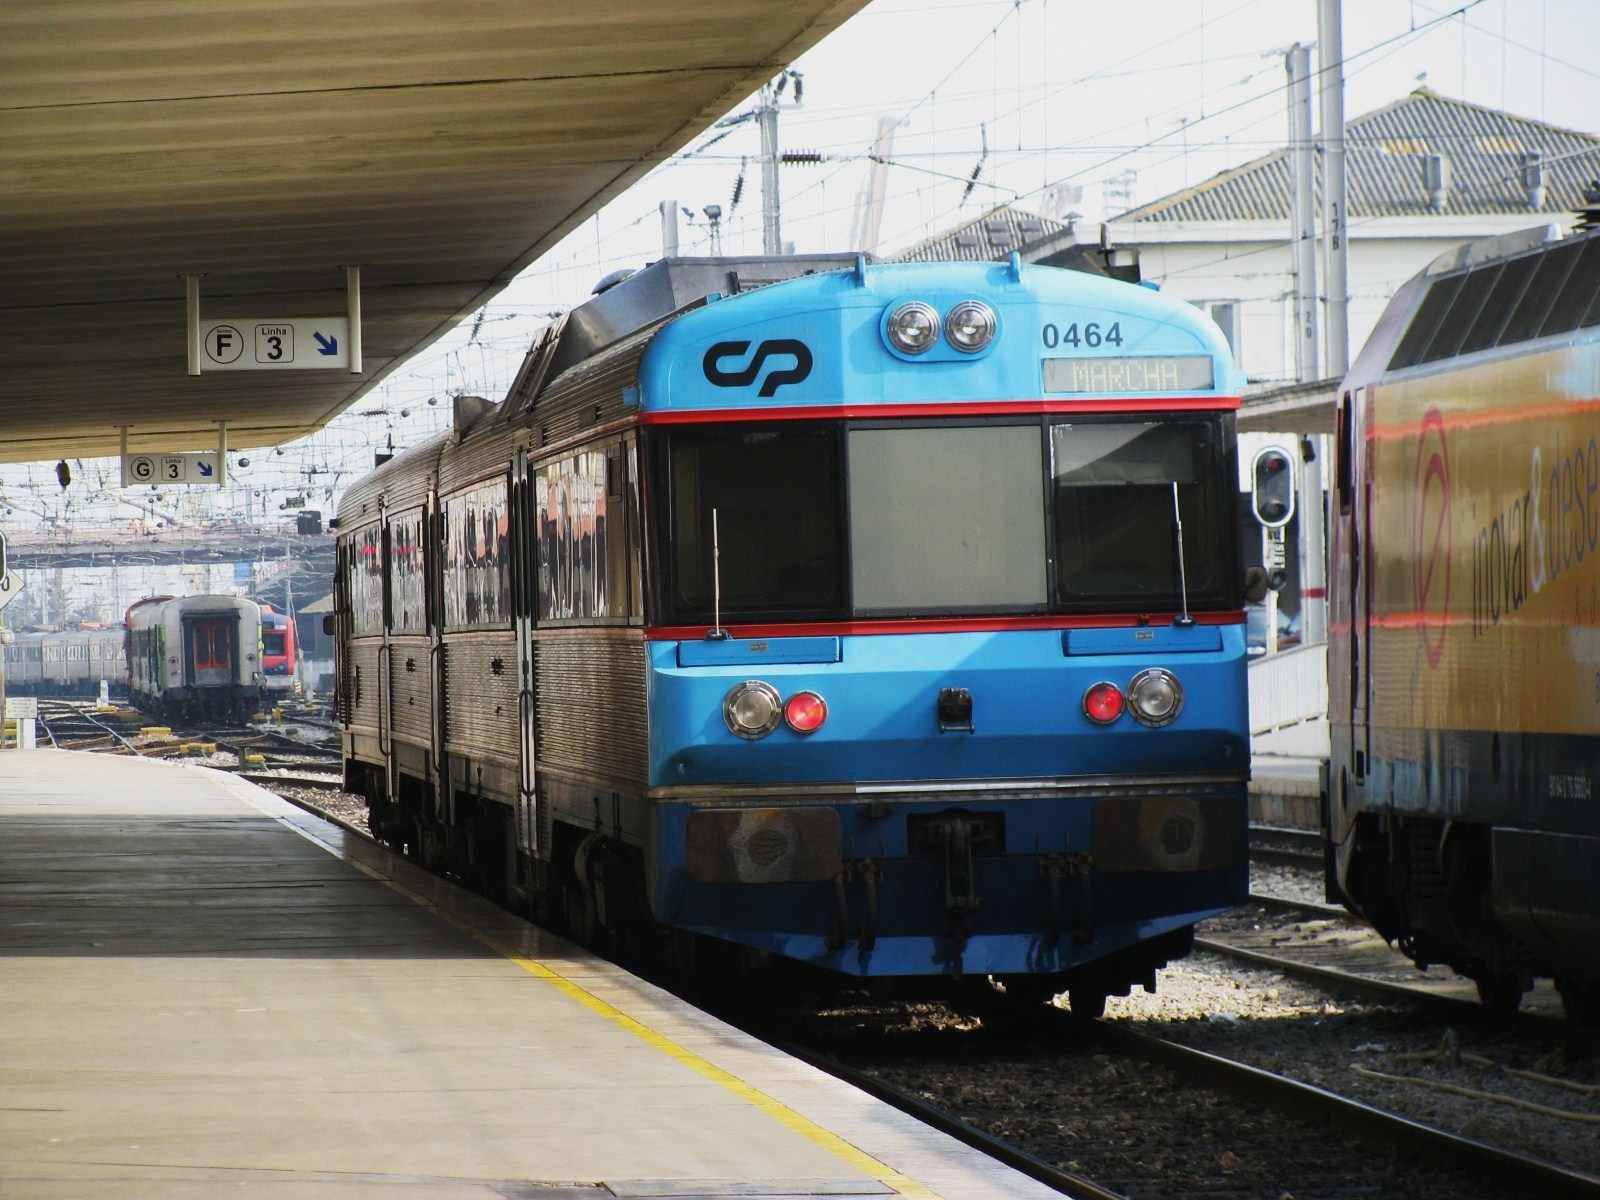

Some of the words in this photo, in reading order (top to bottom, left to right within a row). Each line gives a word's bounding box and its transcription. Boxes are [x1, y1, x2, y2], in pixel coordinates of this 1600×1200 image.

[262, 327, 287, 336] Linha
[1042, 322, 1124, 349] 0464
[216, 334, 233, 357] F
[266, 336, 283, 360] 3
[1072, 360, 1179, 391] MARCHA
[136, 462, 150, 477] G
[168, 463, 179, 479] 3
